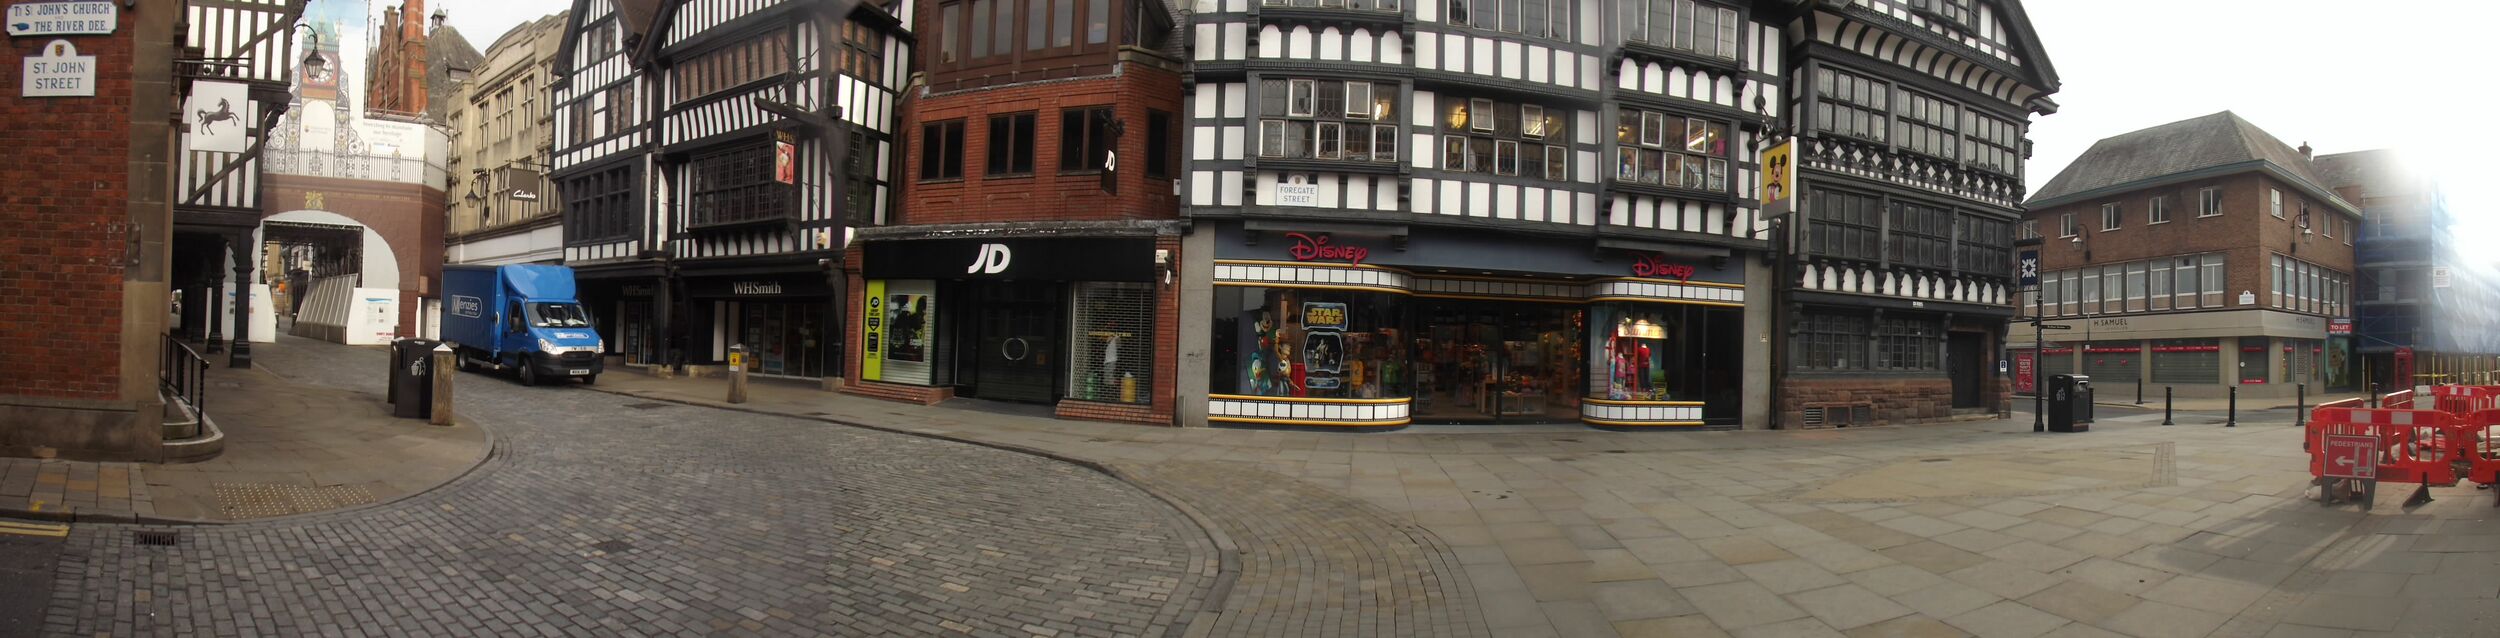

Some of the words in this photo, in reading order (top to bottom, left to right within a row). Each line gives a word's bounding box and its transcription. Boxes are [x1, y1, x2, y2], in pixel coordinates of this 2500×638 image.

[37, 3, 68, 15] JOHN'S
[73, 2, 110, 14] CHURCH
[35, 21, 52, 32] THE
[56, 20, 84, 32] RIVER
[33, 62, 47, 74] ST
[52, 62, 85, 73] JOHN
[35, 77, 81, 89] STREET
[1105, 150, 1115, 171] JD
[513, 189, 536, 199] Clarks
[1280, 186, 1315, 195] FOREGATE
[1283, 195, 1310, 203] STREET
[967, 243, 1011, 274] JD
[733, 281, 782, 295] WHSmith
[1306, 307, 1343, 317] STAR
[1306, 315, 1343, 325] WARS
[2100, 318, 2128, 326] SAMUEL
[2330, 440, 2374, 448] PEDESTRIANS
